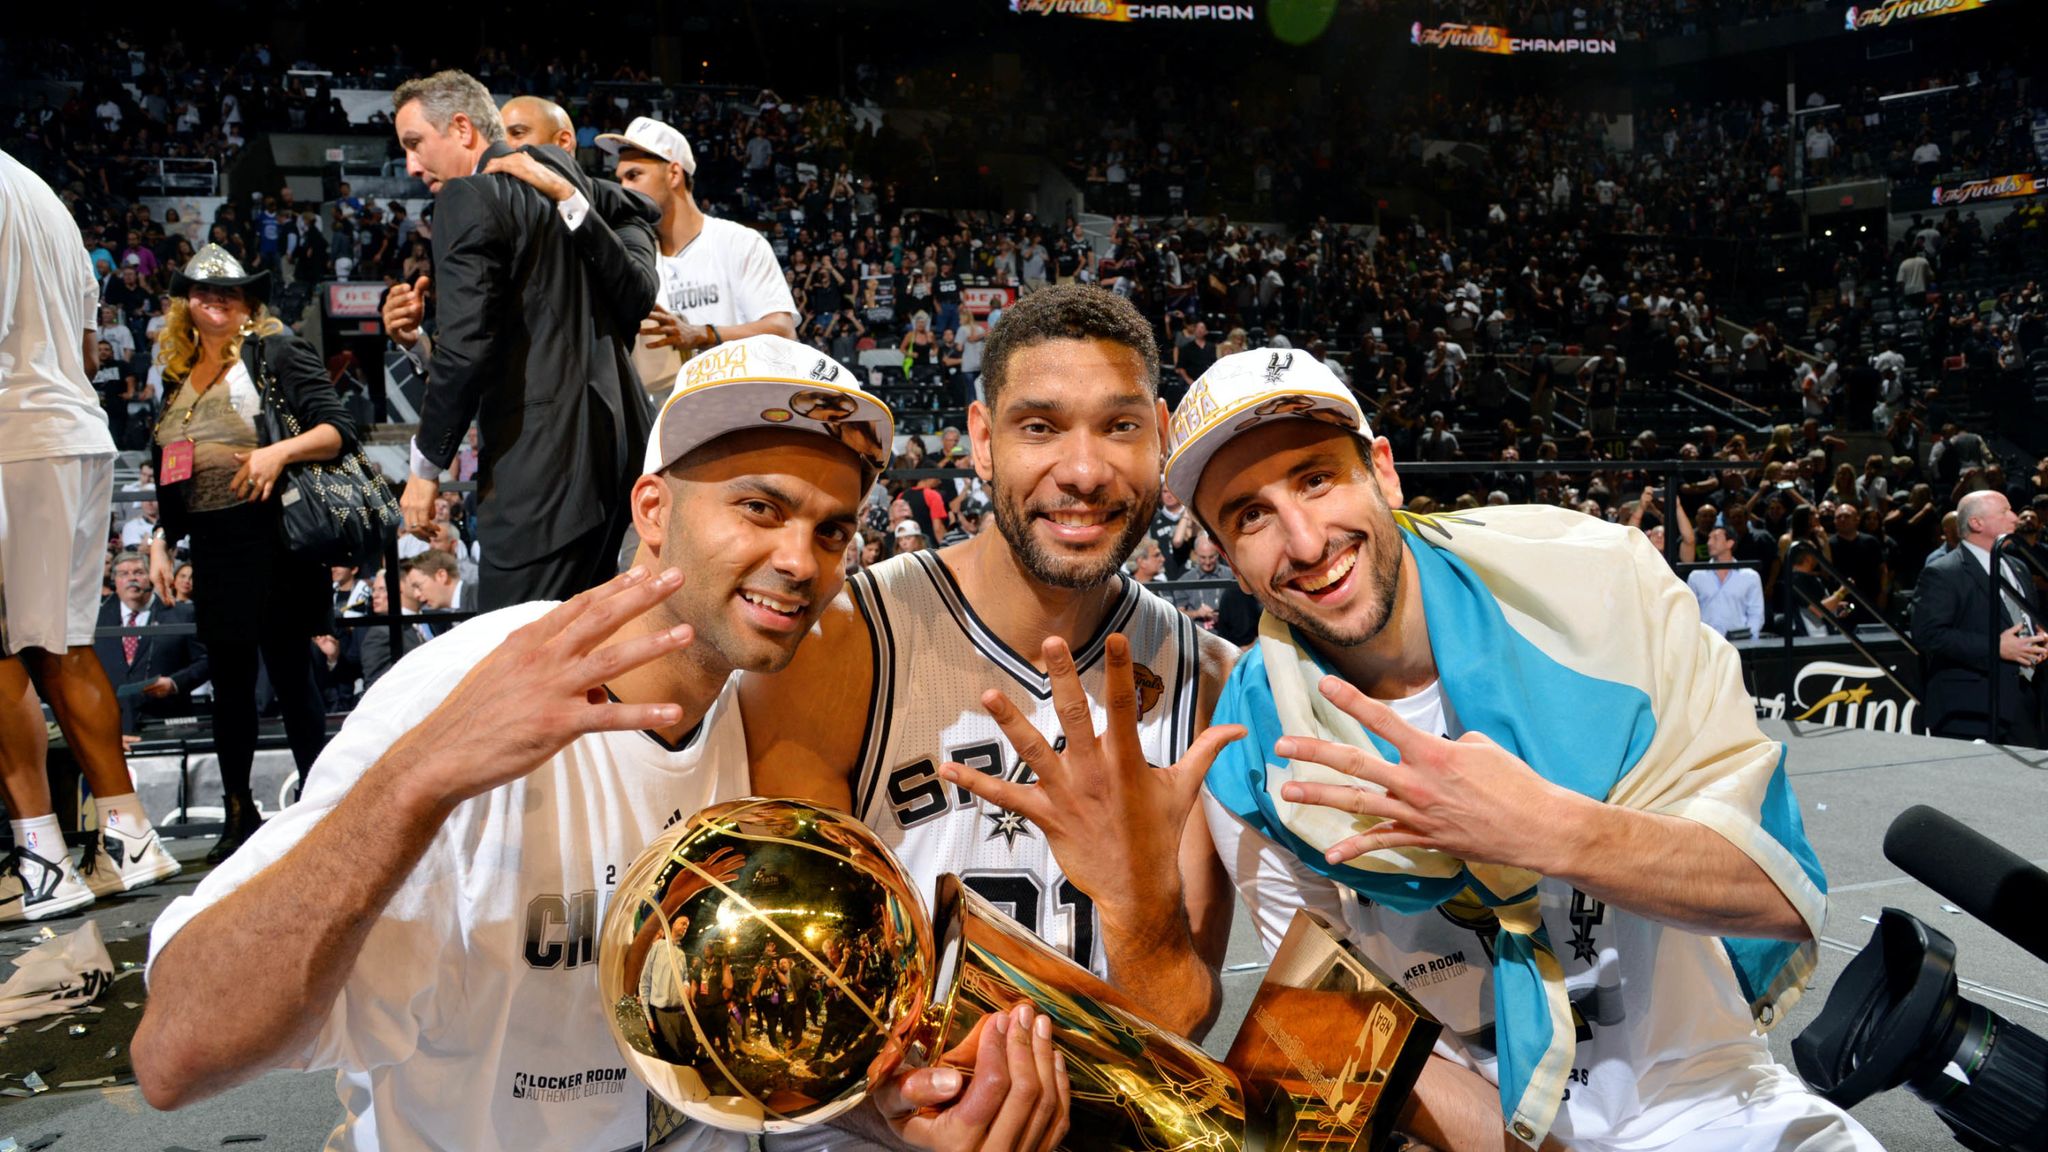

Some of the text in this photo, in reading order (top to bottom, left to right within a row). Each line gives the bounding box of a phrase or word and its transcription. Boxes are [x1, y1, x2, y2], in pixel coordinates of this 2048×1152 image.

[1126, 5, 1254, 20] CHAMPION
[1439, 22, 1496, 49] Finals
[1509, 38, 1616, 54] CHAMPION
[686, 344, 746, 376] 2014
[1428, 950, 1466, 972] ROOM
[1432, 963, 1469, 985] EDITION
[1374, 1012, 1392, 1036] NBA
[528, 1067, 627, 1089] LOCKER ROOM
[526, 1080, 624, 1103] AUTHENTIC EDITION
